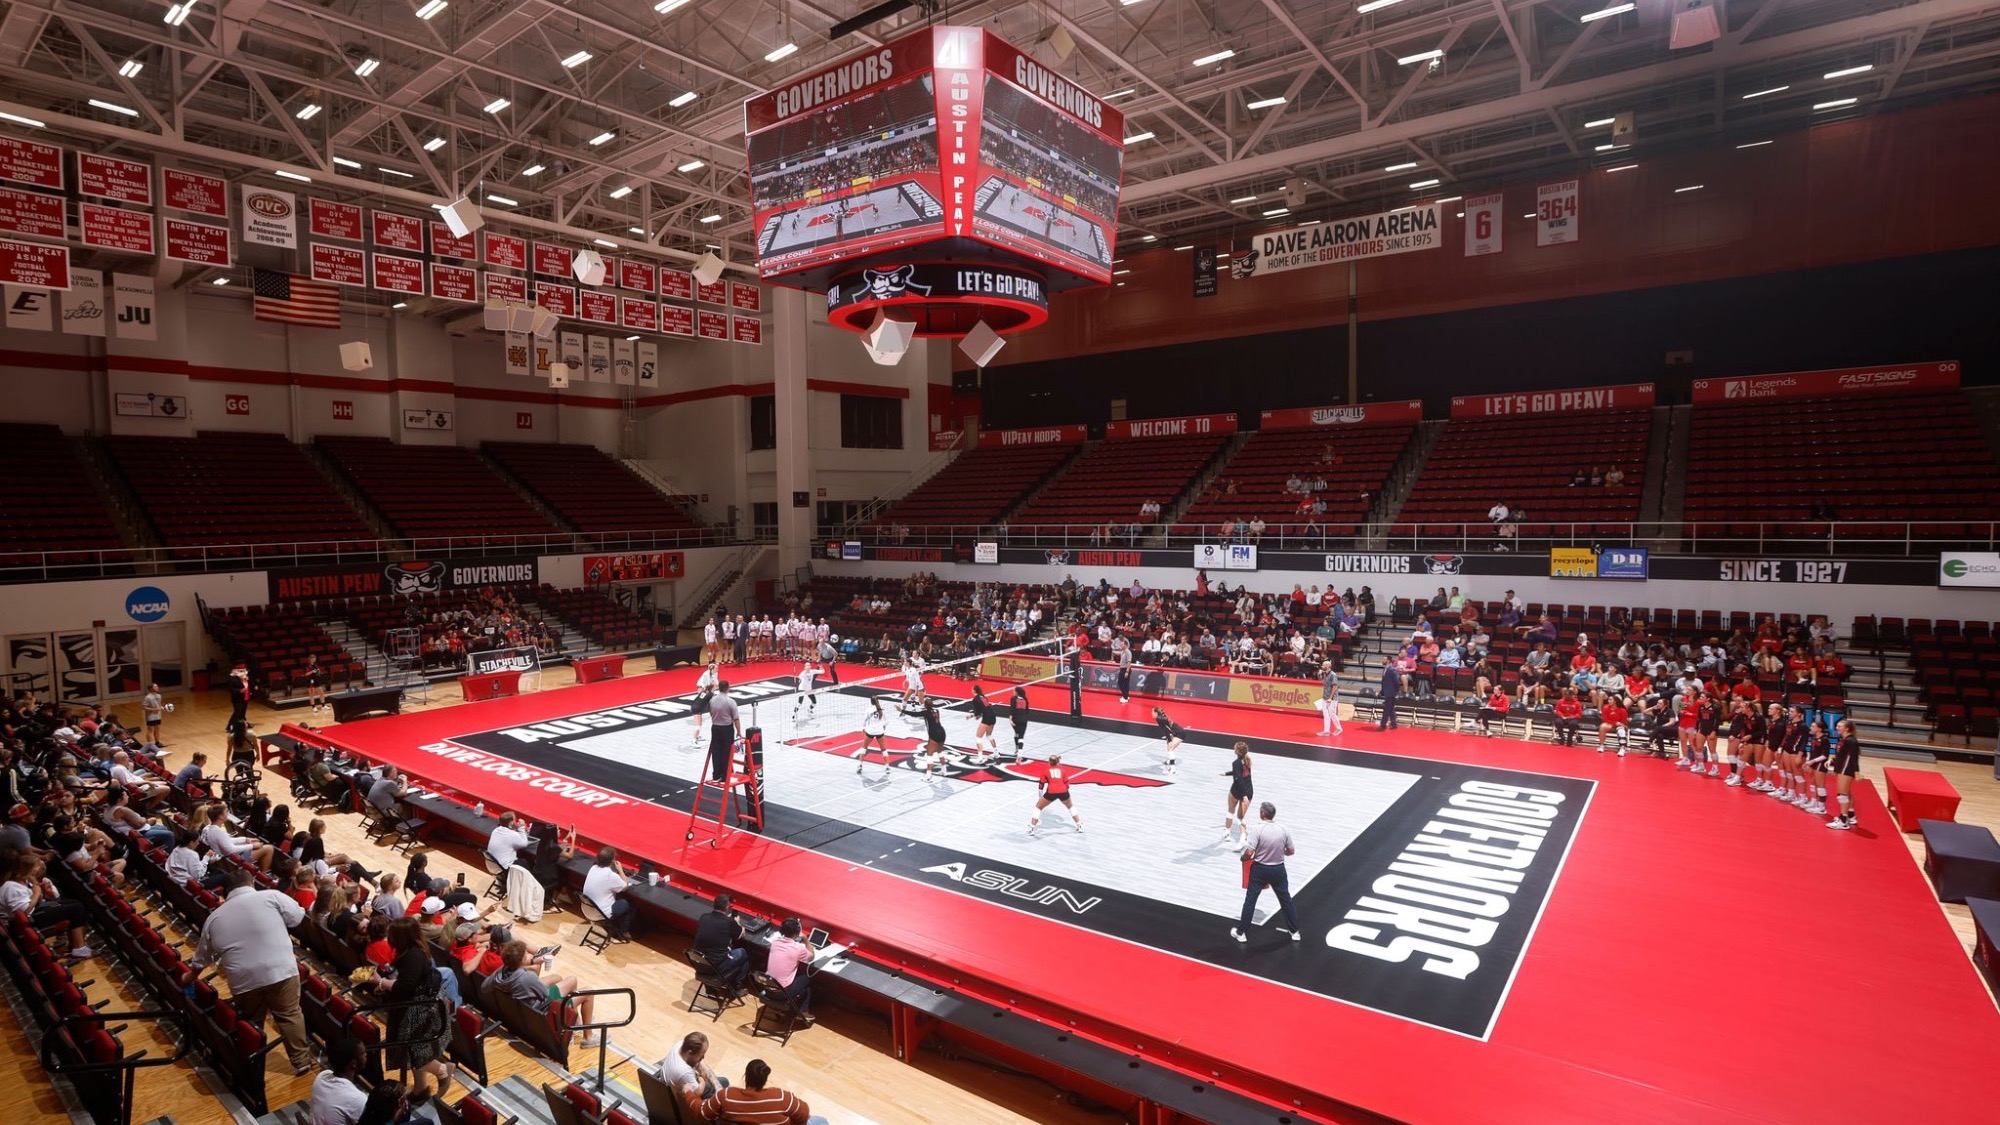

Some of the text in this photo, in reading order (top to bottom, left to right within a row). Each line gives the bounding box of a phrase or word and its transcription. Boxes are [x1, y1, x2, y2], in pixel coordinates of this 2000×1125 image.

[777, 48, 893, 119] GOVERNORS
[1015, 54, 1102, 128] GOVERNORS
[951, 72, 970, 236] AUSTIN PEAY
[86, 156, 142, 173] AUSTIN PEAY
[106, 168, 125, 177] OVC
[169, 171, 221, 188] AUSTIN PEAY
[1540, 182, 1577, 195] AUSTIN PEAY
[35, 195, 59, 206] PEAY
[255, 199, 283, 213] OVC
[1539, 195, 1576, 222] 364
[170, 222, 225, 237] AUSTIN PEAY
[253, 219, 287, 231] Academic
[1476, 210, 1492, 240] 6
[1547, 218, 1568, 229] WINS
[189, 233, 206, 241] OVC
[248, 224, 293, 239] Achievement
[1263, 208, 1438, 257] DAVE AARON ARENA
[16, 252, 44, 262] ASUN
[38, 247, 62, 257] PEAY
[188, 252, 208, 261] 2017
[315, 246, 361, 259] AUSTIN PEAY
[1267, 233, 1433, 270] HOME OF THE GOVERNORS SINCE 1975
[377, 256, 400, 266] AUSTIN
[957, 270, 1039, 300] LET'S GO PEAY!
[118, 305, 151, 325] JU
[1749, 377, 1797, 389] Legends
[1838, 369, 1918, 384] FASTSIGNS
[1638, 385, 1653, 393] NN
[1749, 387, 1777, 398] Bank
[227, 399, 248, 411] GG
[1453, 398, 1465, 406] NN
[1485, 394, 1527, 417] LET'S
[1532, 393, 1556, 414] GO
[333, 405, 352, 417] HH
[1311, 406, 1365, 421] STACHEVILLE
[1130, 418, 1211, 437] WELCOME TO
[1034, 430, 1061, 443] HOOPS
[1078, 551, 1141, 566] AUSTIN PEAY
[1324, 555, 1410, 575] GOVERNORS
[1553, 557, 1594, 565] recyclops
[453, 563, 533, 586] GOVERNORS
[1720, 560, 1848, 583] SINCE 1927
[1969, 564, 1997, 573] ECHO
[279, 573, 380, 598] AUSTIN PEAY
[131, 602, 169, 614] NCAA
[479, 655, 531, 672] STACHEVILLE
[999, 659, 1042, 678] Bojangles
[1136, 674, 1146, 687] 2
[1208, 681, 1216, 694] 1
[1249, 683, 1310, 704] Bojangles
[497, 698, 692, 743] AUSTIN
[417, 742, 631, 808] DAVE LOOS COURT
[1049, 768, 1062, 779] 10
[920, 861, 1102, 914] ASUN
[1325, 780, 1566, 980] GOVERNORS
